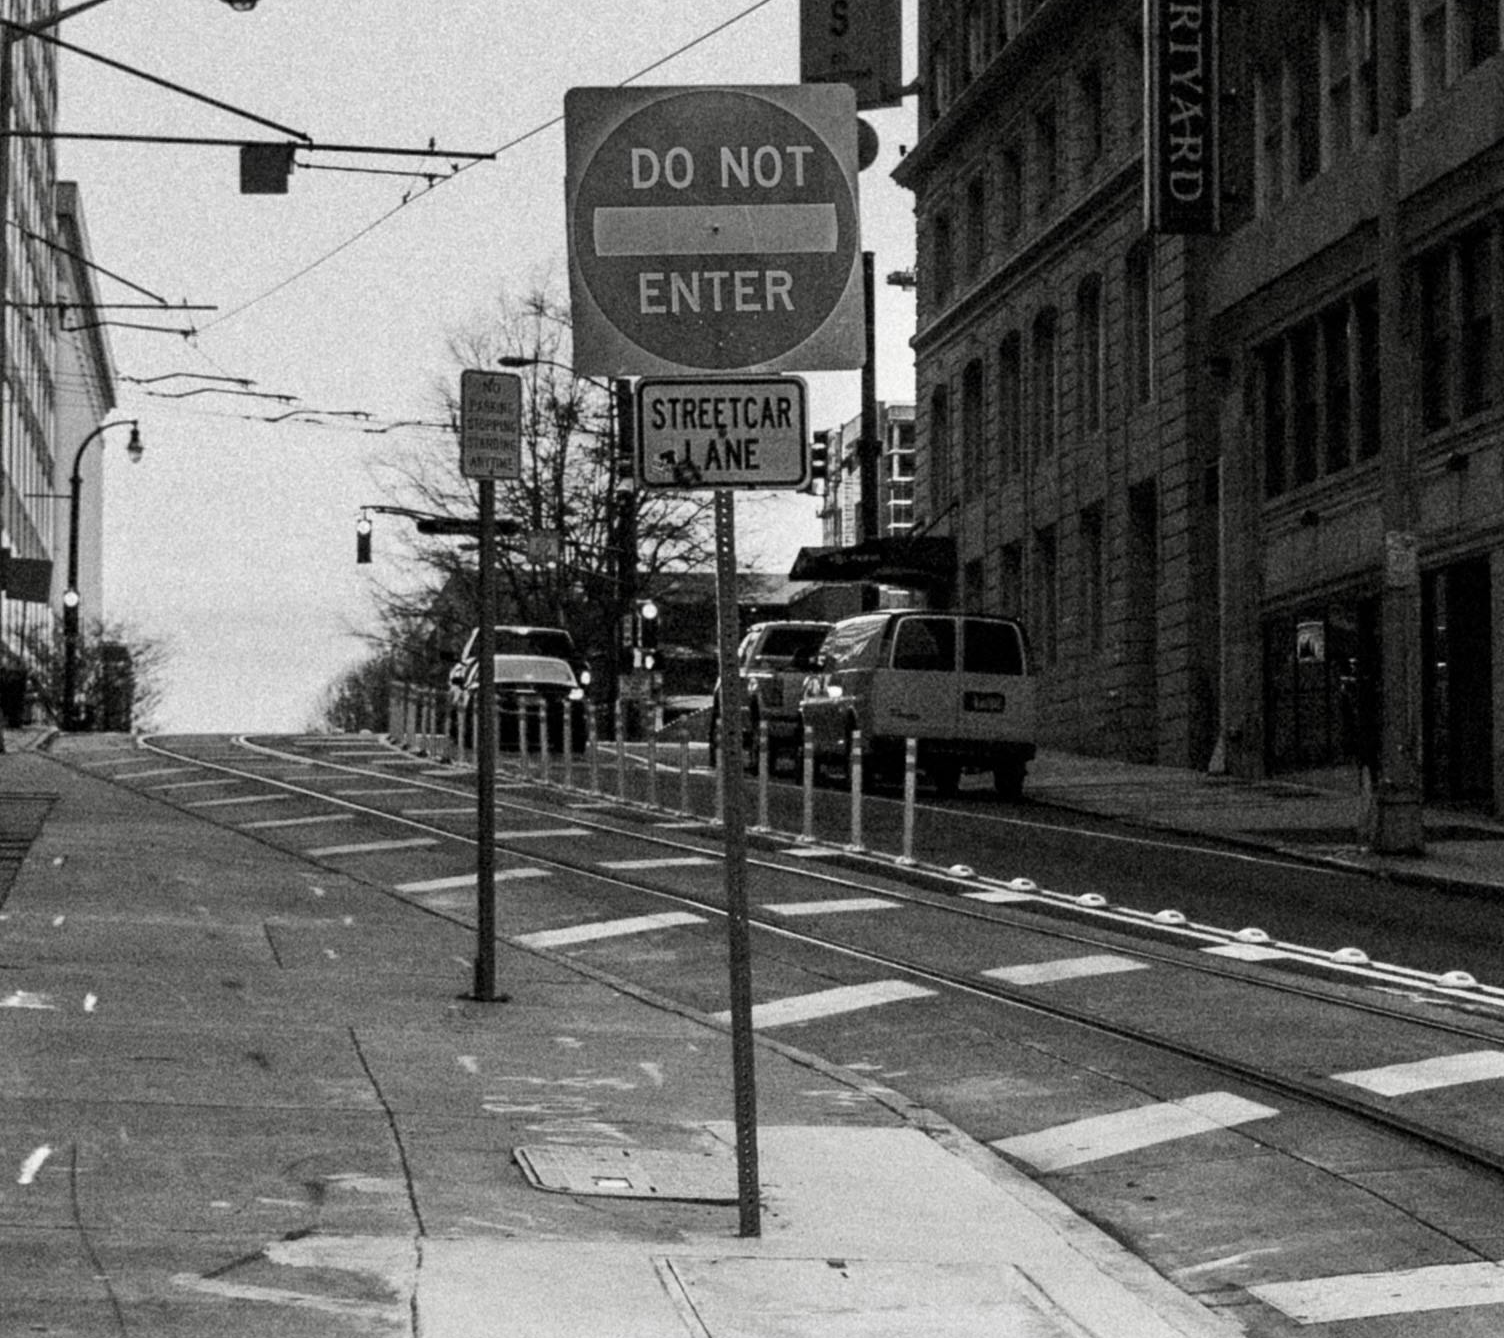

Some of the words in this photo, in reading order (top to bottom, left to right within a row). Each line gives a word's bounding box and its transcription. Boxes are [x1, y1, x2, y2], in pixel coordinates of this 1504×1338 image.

[631, 146, 694, 189] DO
[719, 145, 814, 188] NOT
[639, 269, 795, 314] ENTER
[482, 377, 501, 394] NO
[469, 398, 515, 416] PARKING
[652, 396, 792, 431] STREETCAR
[684, 438, 761, 471] LANE
